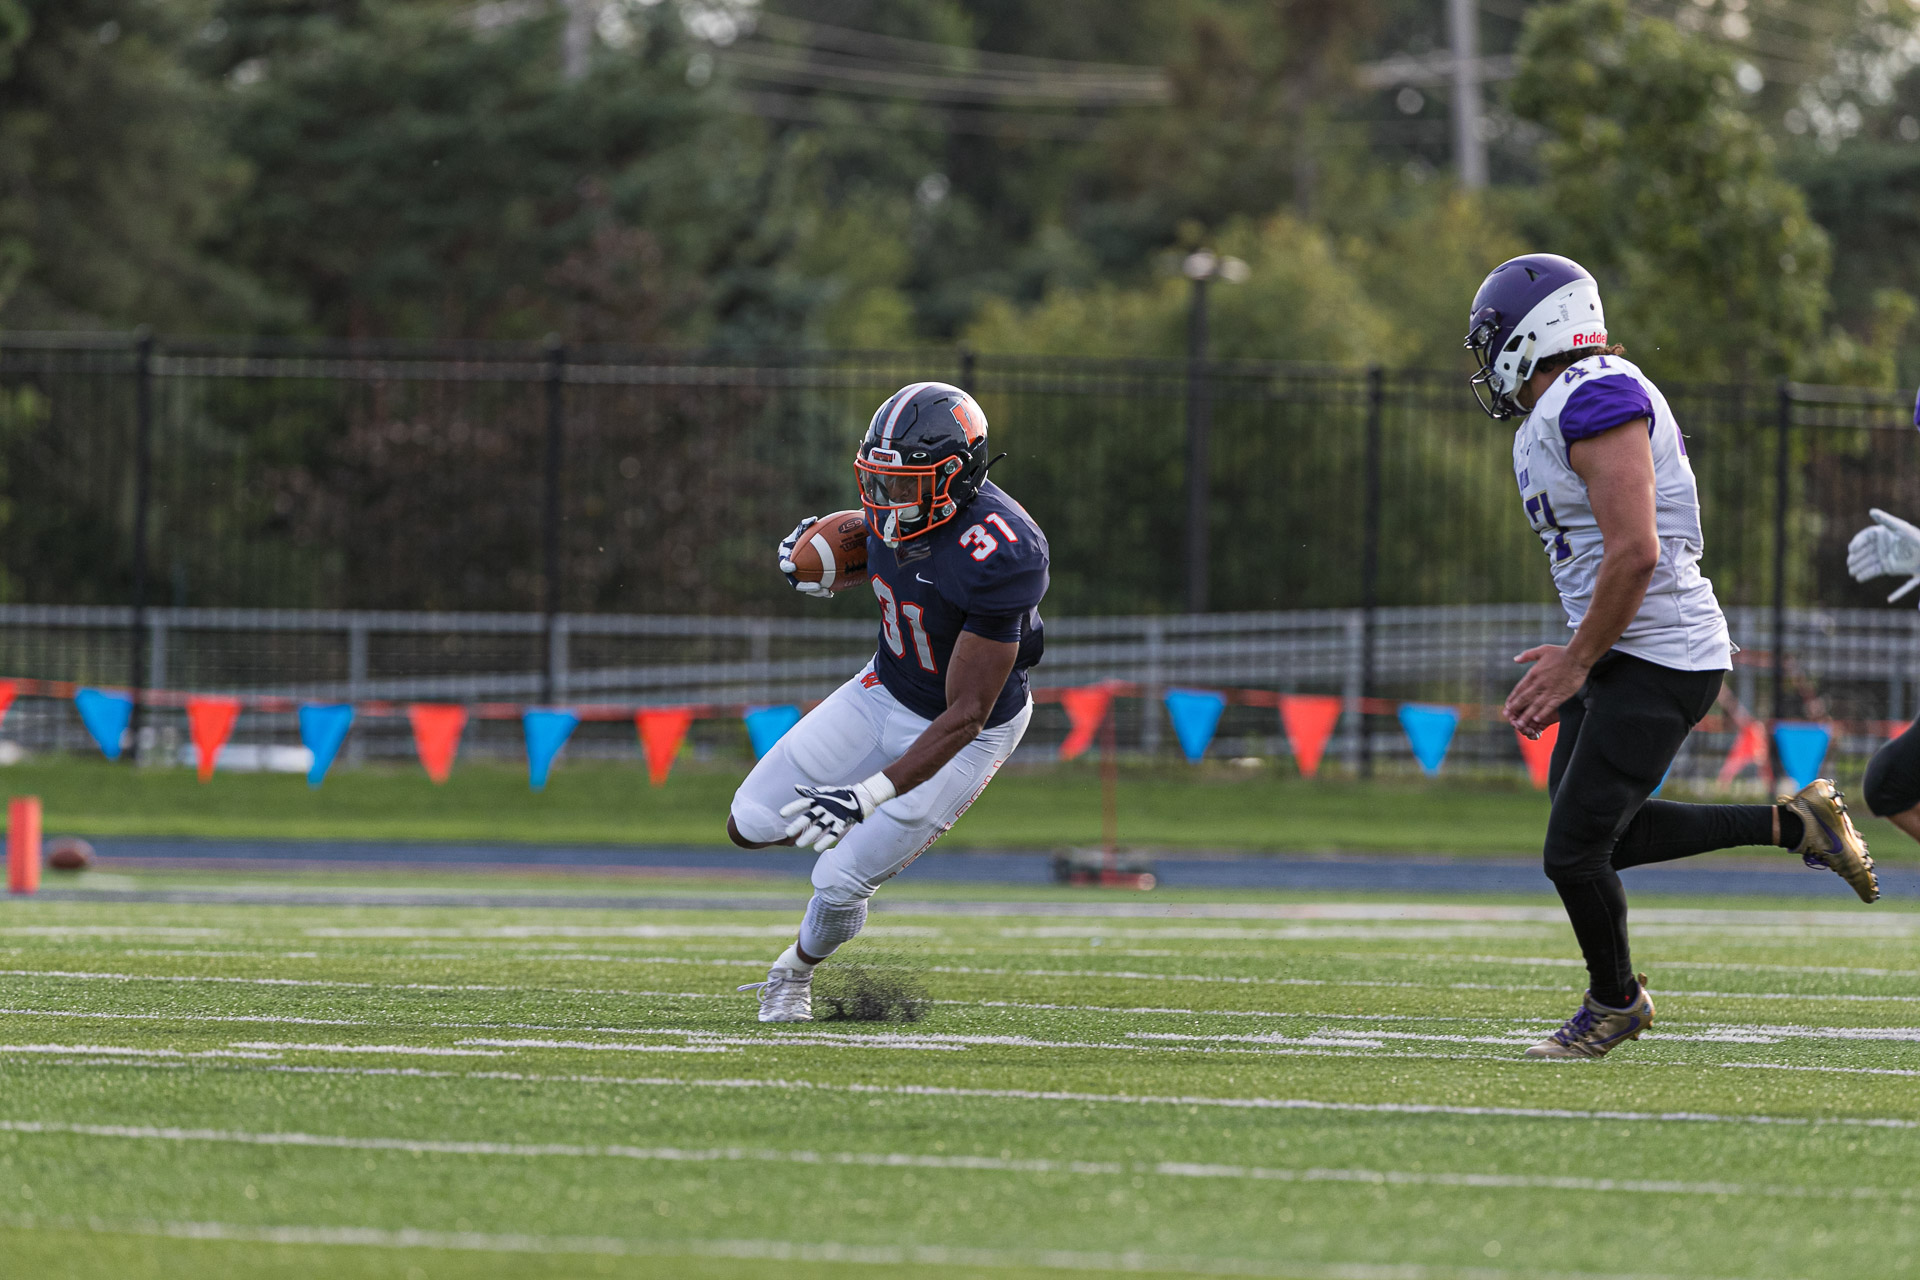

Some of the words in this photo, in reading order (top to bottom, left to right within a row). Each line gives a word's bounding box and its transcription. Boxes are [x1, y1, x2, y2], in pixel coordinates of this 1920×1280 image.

[840, 519, 863, 532] GST
[958, 512, 1018, 561] 31
[870, 573, 938, 674] 31
